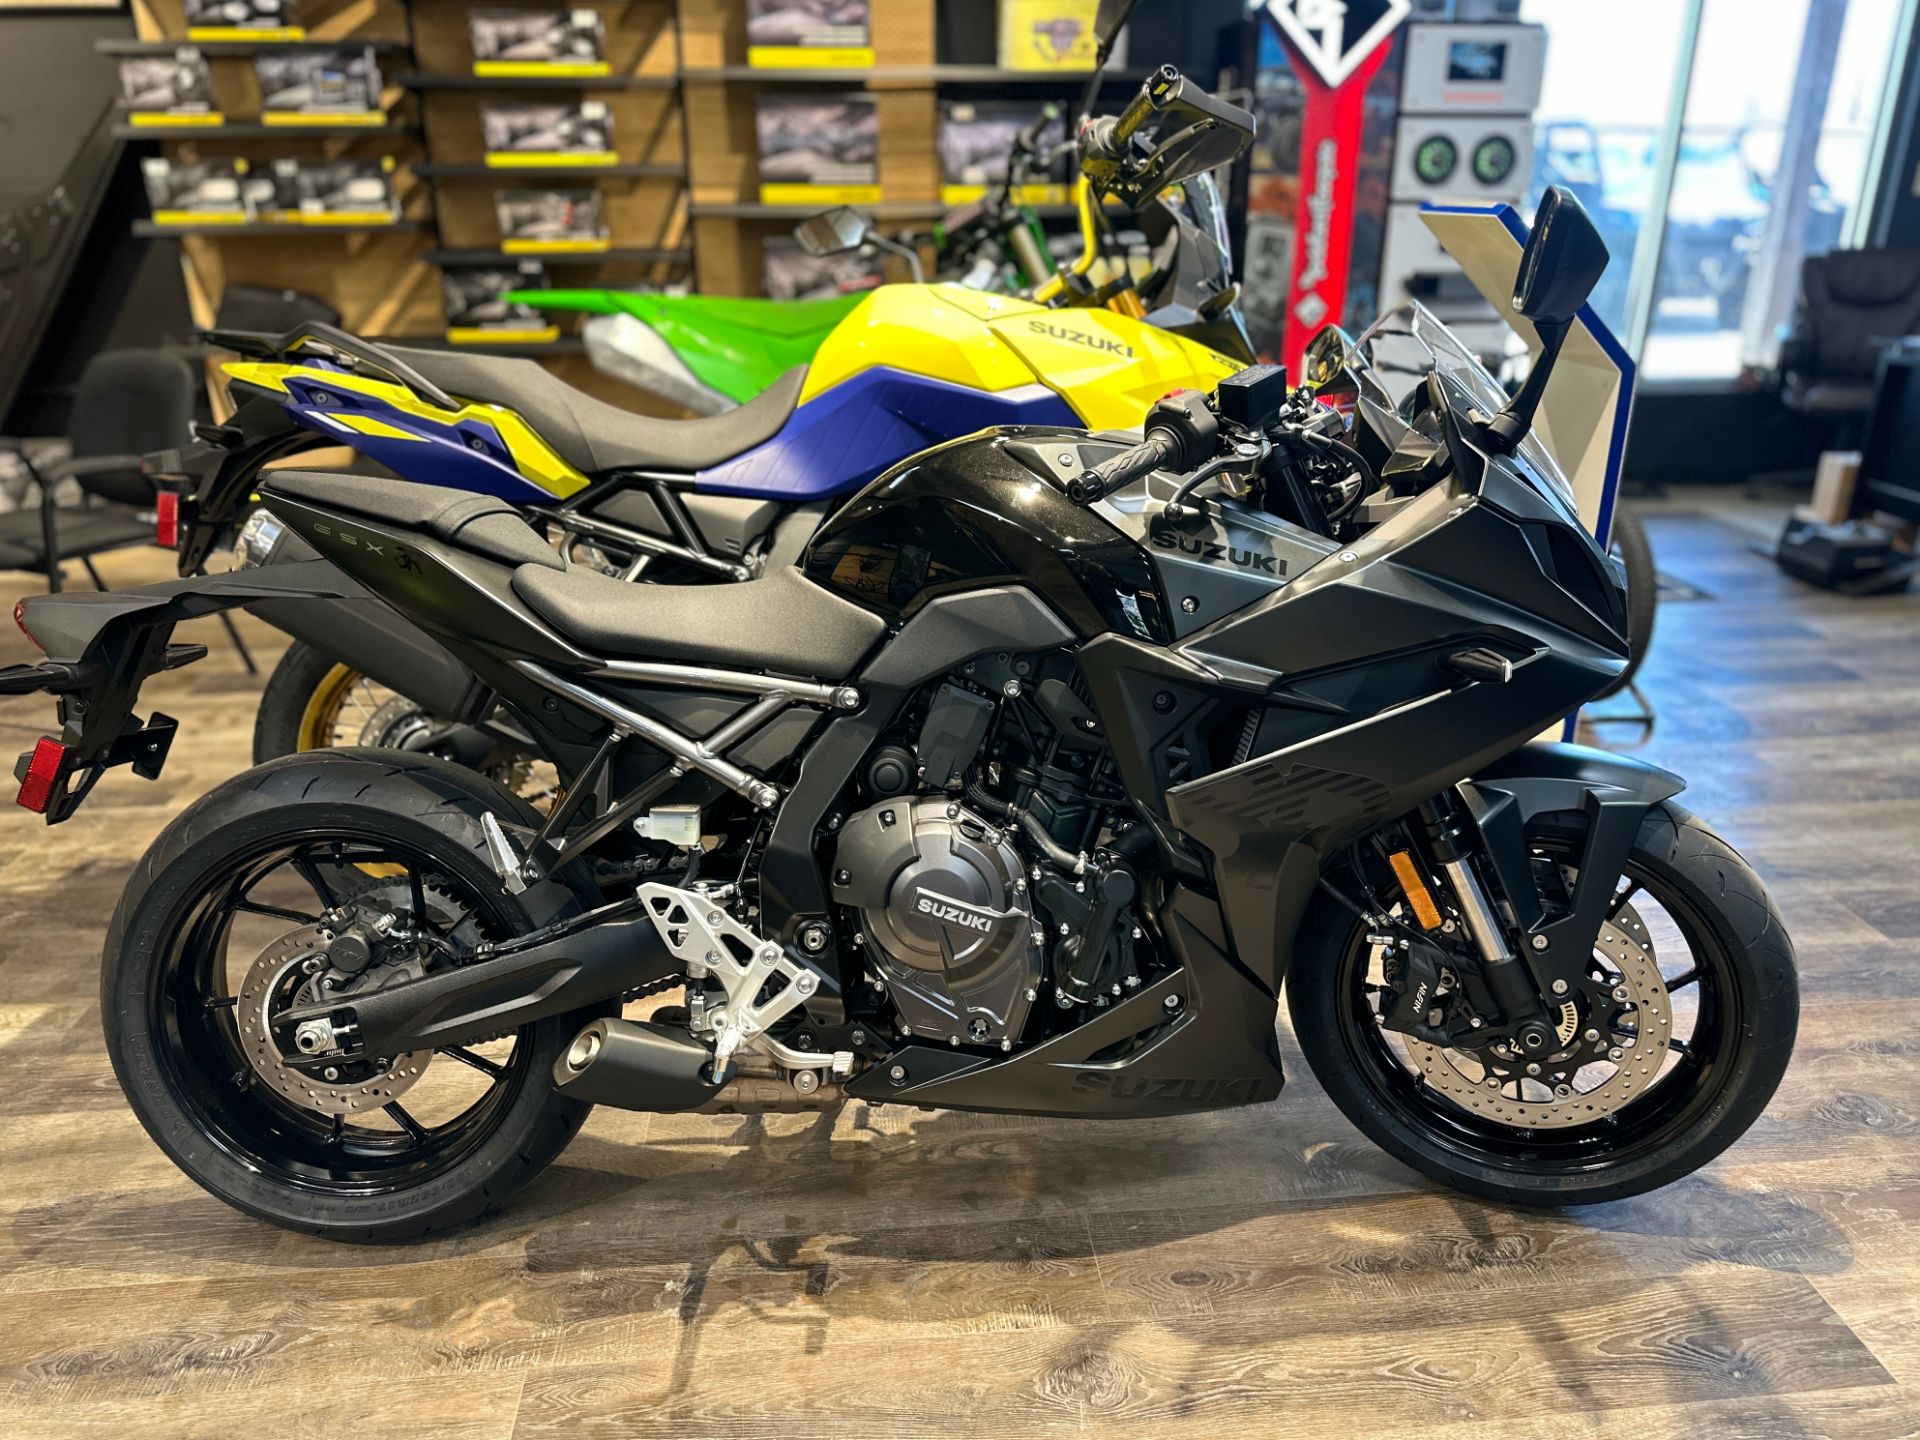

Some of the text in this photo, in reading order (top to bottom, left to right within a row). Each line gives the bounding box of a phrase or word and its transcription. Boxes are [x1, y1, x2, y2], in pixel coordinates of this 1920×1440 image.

[1028, 320, 1133, 357] SUZUKI
[1152, 531, 1288, 576] SUZUKI
[917, 898, 992, 932] SUZUKI
[1071, 1072, 1263, 1100] SUZUKI
